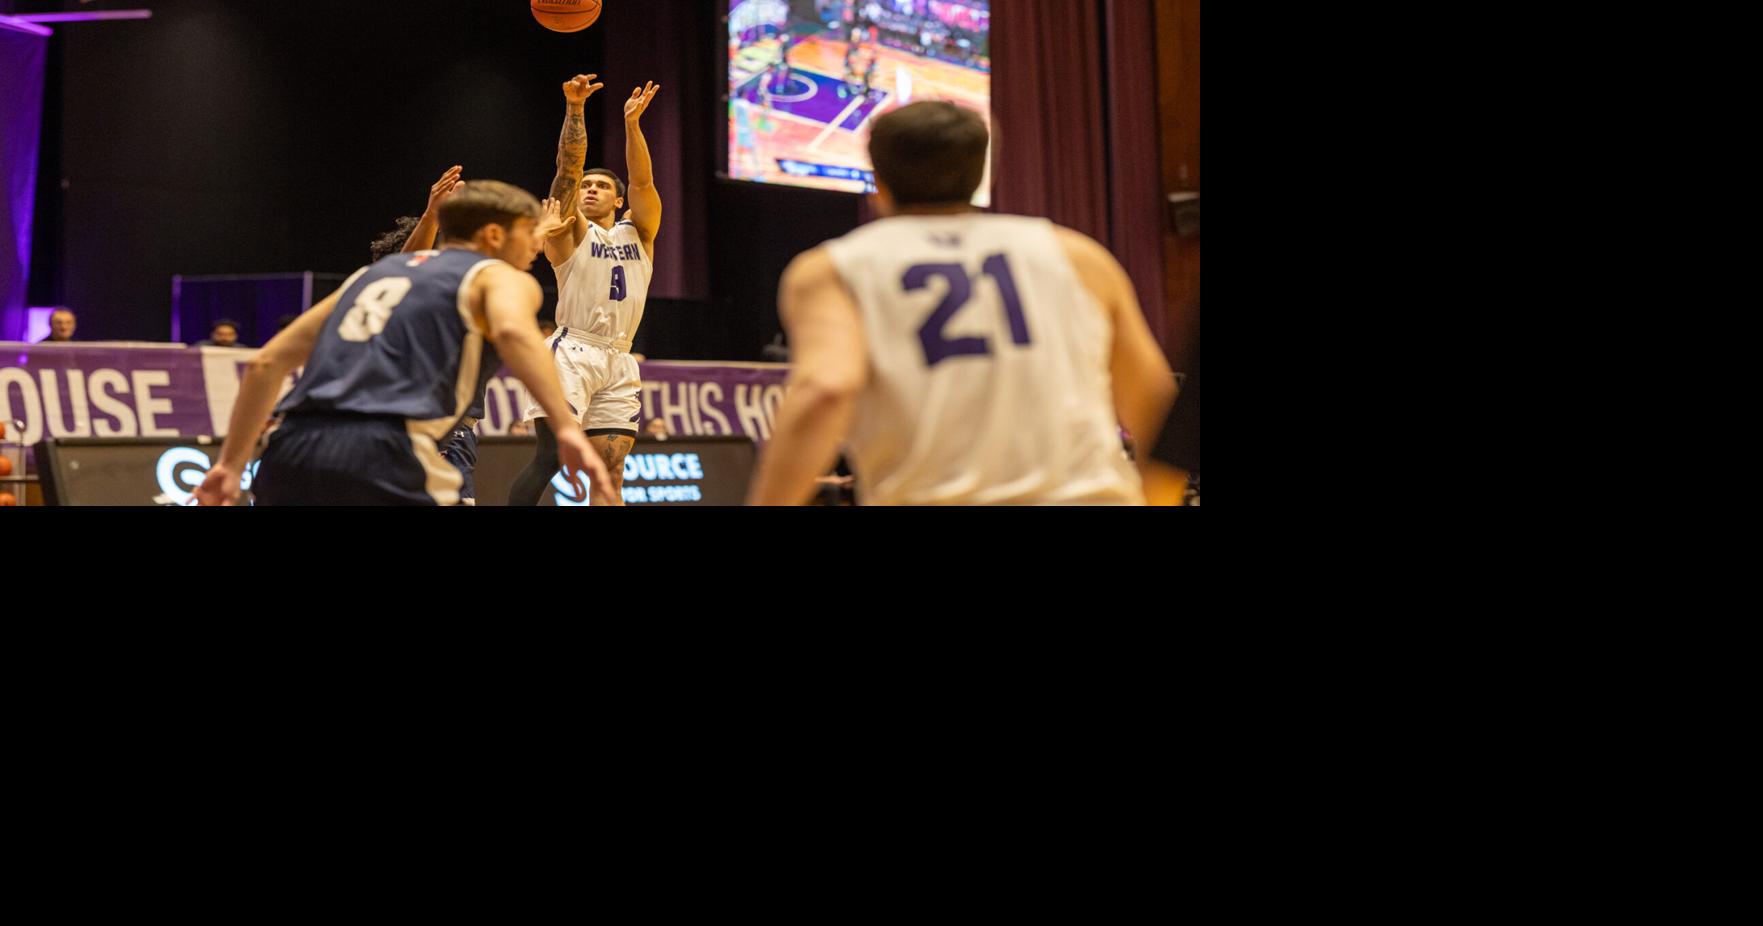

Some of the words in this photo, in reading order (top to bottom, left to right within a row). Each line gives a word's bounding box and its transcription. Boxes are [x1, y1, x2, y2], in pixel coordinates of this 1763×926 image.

[338, 276, 412, 342] 8
[609, 265, 627, 301] 9
[901, 252, 1032, 367] 21
[0, 367, 181, 446] OUSE
[639, 381, 733, 436] THIS
